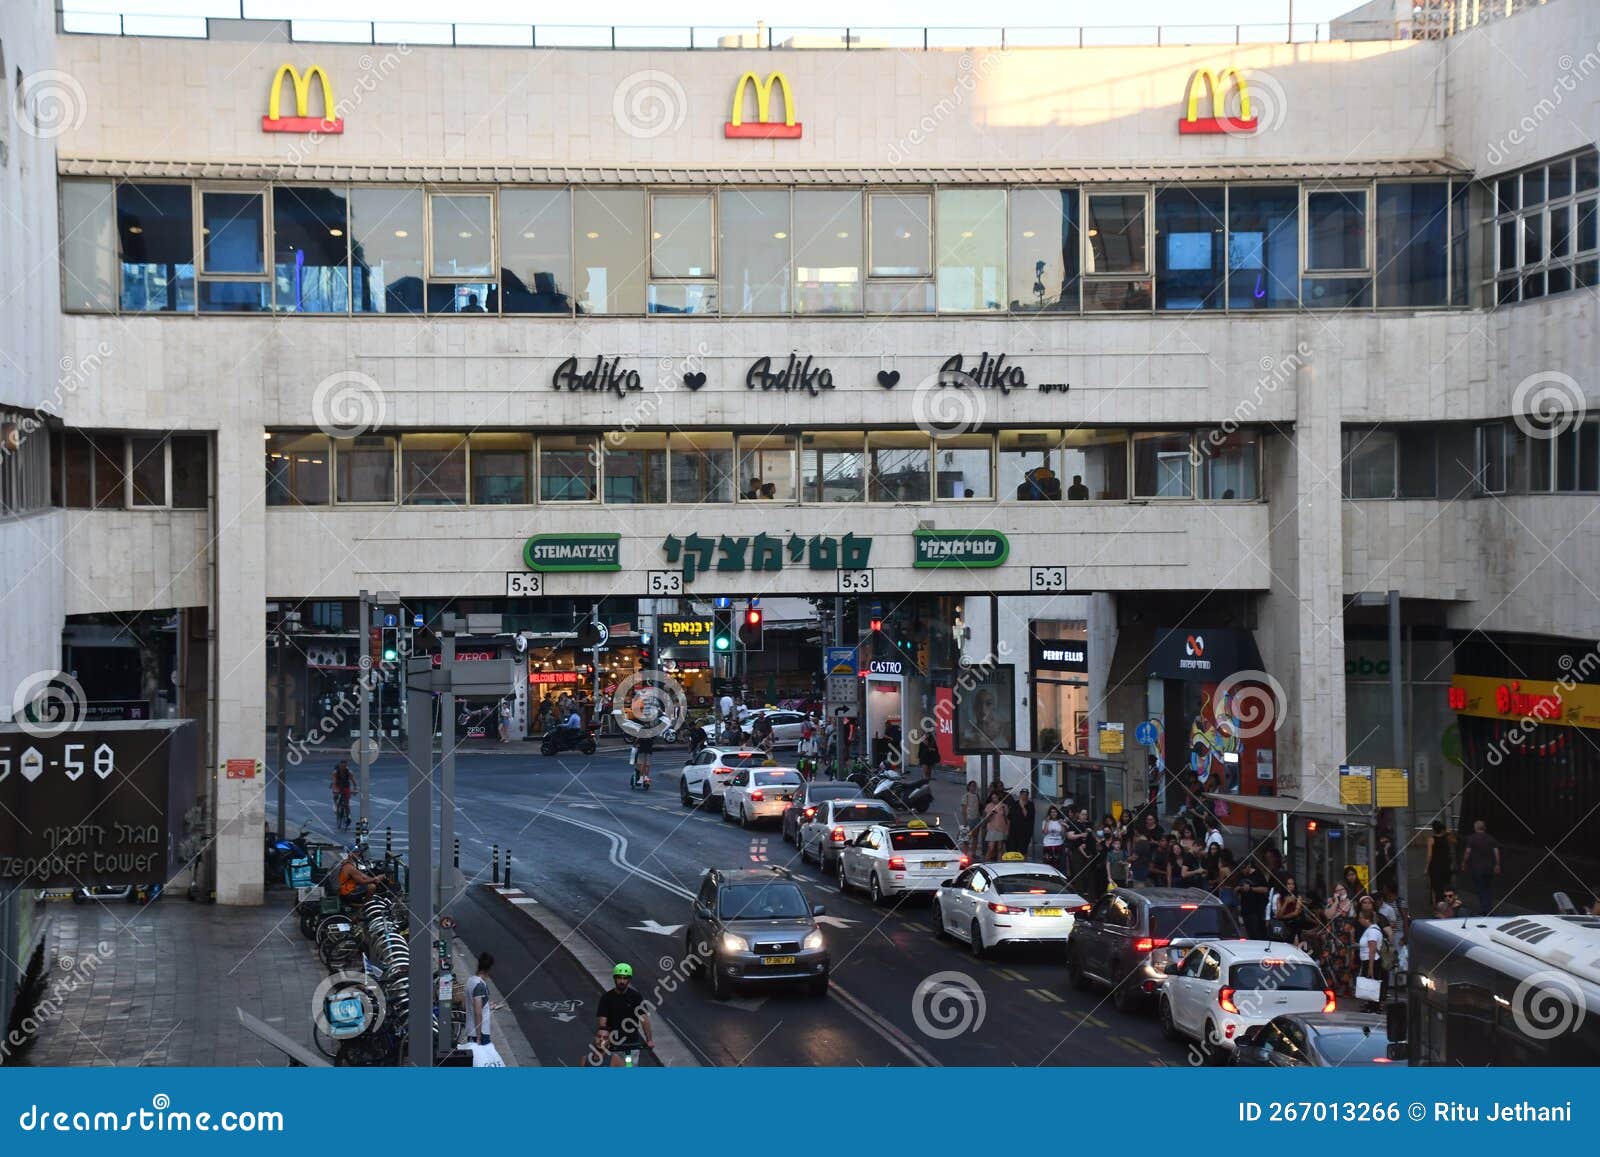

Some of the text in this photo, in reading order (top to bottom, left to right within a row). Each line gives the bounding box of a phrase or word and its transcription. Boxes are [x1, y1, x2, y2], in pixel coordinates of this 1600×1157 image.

[552, 354, 644, 398] Adika
[746, 353, 836, 397] Adika
[938, 351, 1028, 396] Adika
[534, 544, 616, 559] STEIMATZKY
[662, 531, 873, 583] סטימצקי
[920, 539, 997, 559] סטימצקי
[512, 577, 539, 592] 5.3
[652, 576, 680, 591] 5.3
[842, 574, 870, 590] 5.3
[1035, 571, 1062, 587] 5.3
[1043, 650, 1084, 662] PERRY ELLIS
[870, 661, 902, 673] CASTRO
[940, 719, 953, 734] SAL
[0, 851, 159, 881] zengoff tower
